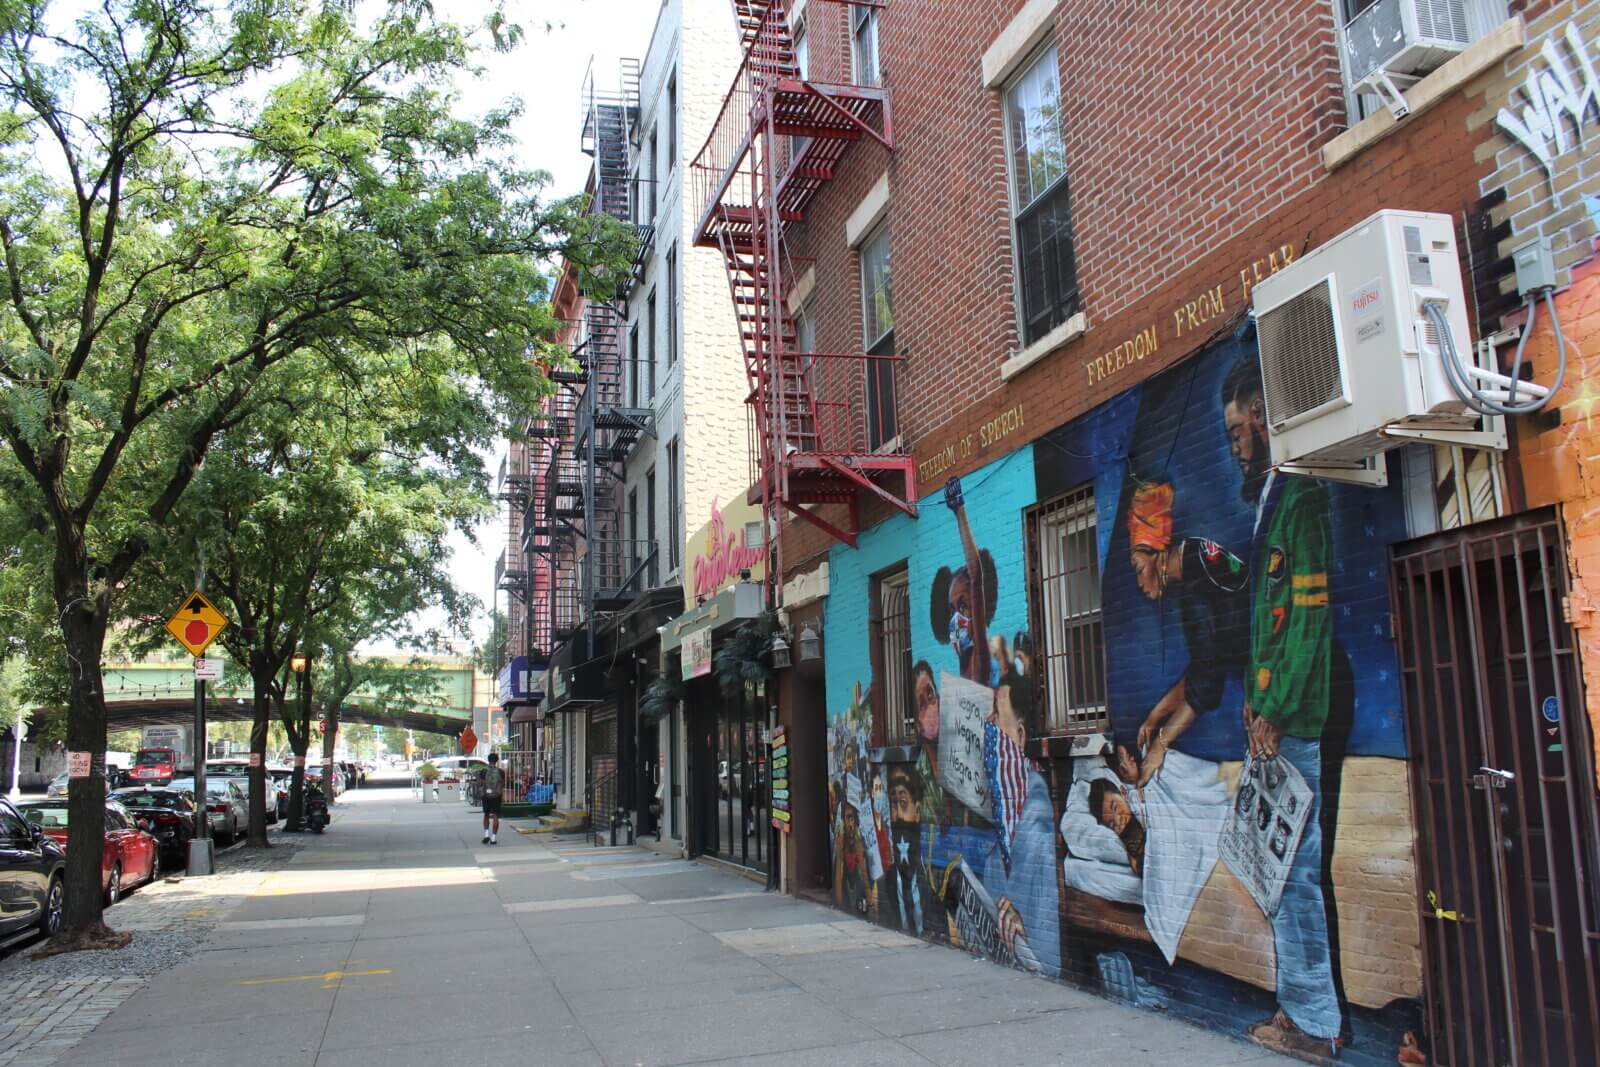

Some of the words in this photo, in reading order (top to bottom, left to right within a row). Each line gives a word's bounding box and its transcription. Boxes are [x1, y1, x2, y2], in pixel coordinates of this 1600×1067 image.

[1086, 324, 1158, 386] FREEDOM
[1174, 285, 1225, 337] FROM
[1240, 244, 1294, 300] FEAR
[1353, 290, 1379, 310] FUJITSU
[919, 444, 956, 483] FREEDOM
[960, 433, 973, 458] OF
[980, 403, 1024, 447] SPEECH
[957, 694, 984, 728] egra,
[960, 876, 976, 916] NO
